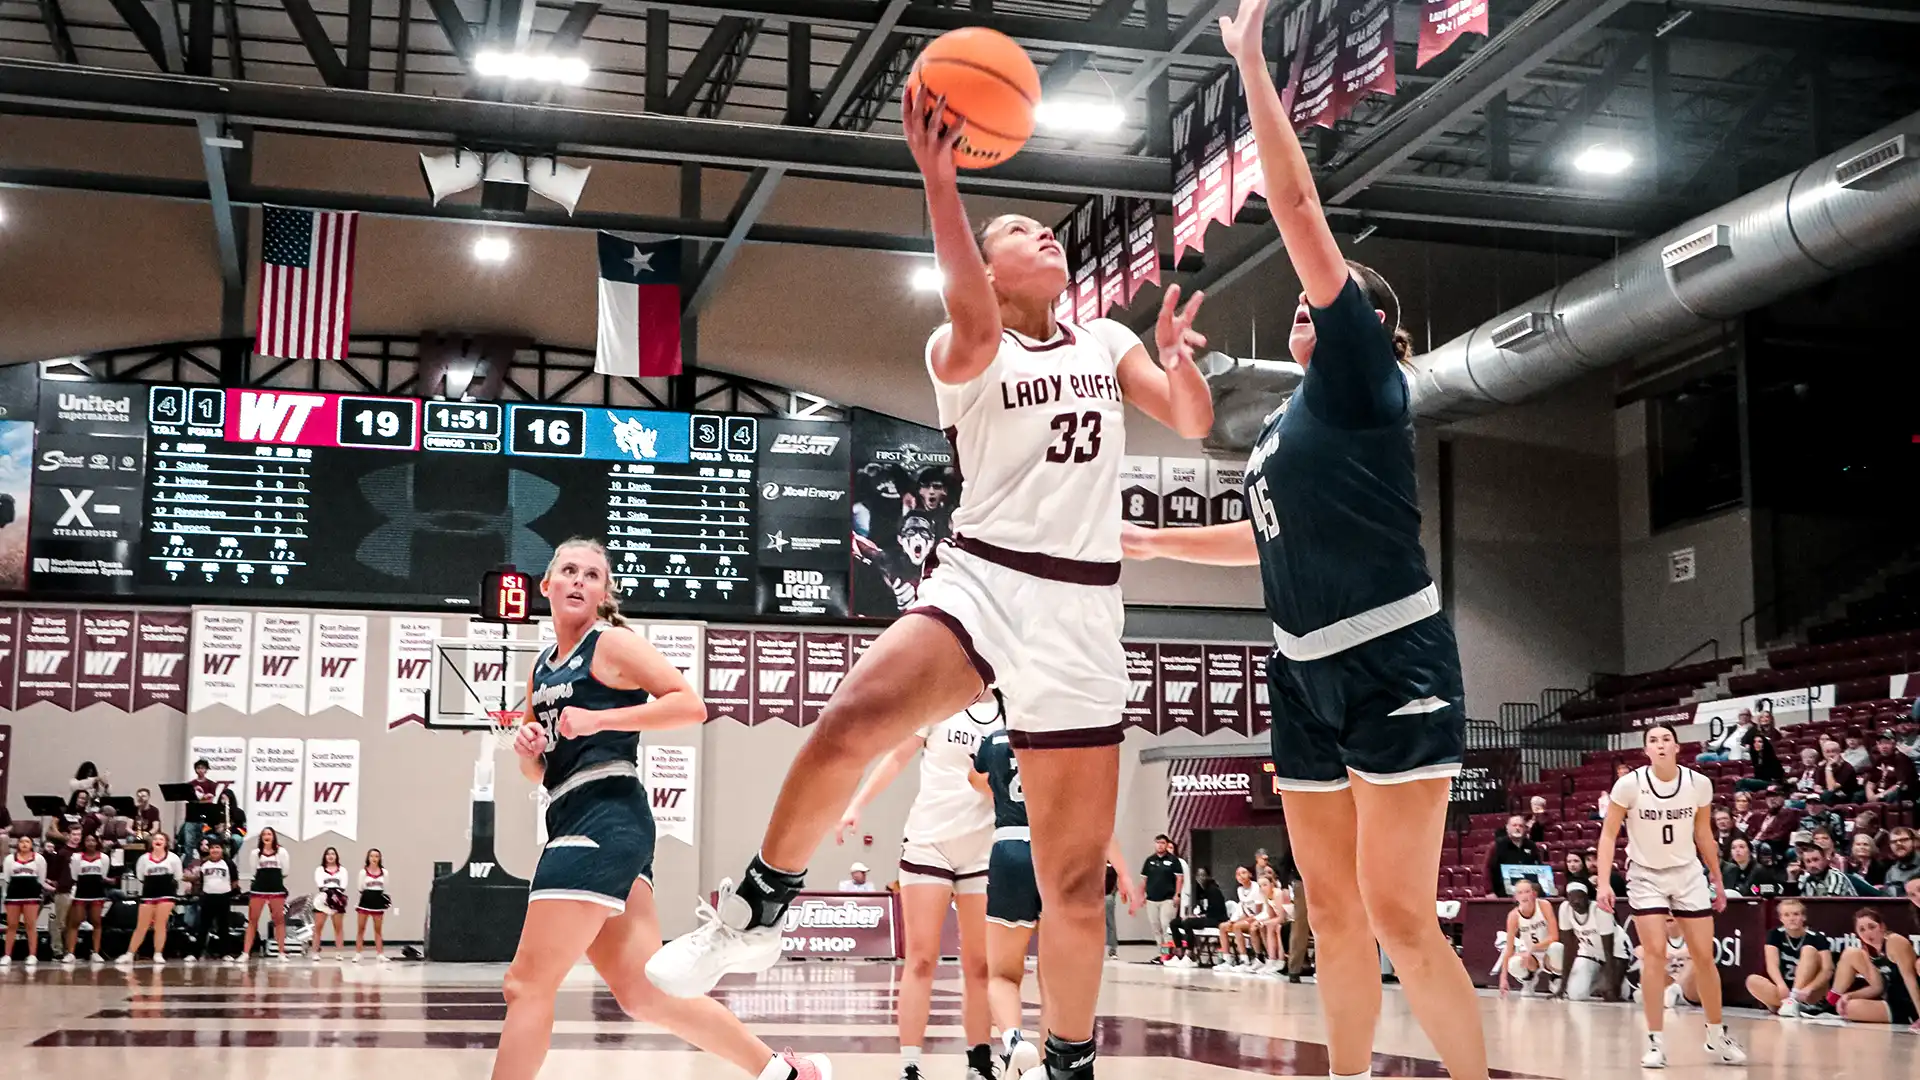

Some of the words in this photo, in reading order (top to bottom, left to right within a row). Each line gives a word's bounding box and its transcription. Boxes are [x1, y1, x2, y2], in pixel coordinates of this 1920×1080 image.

[1001, 375, 1061, 409] LADY
[58, 393, 130, 414] United
[157, 396, 177, 417] 4
[198, 398, 212, 418] 1
[58, 412, 130, 423] supermarkets
[238, 392, 326, 443] WT
[355, 410, 399, 437] 19
[436, 408, 488, 430] 1:51
[527, 418, 571, 446] 16
[699, 424, 715, 443] 3
[734, 425, 751, 444] 4
[1045, 411, 1102, 463] 33
[876, 451, 900, 461] FIRST
[917, 454, 951, 463] UNITED
[1173, 475, 1196, 483] RAMEY
[1219, 477, 1245, 485] CHEEKS
[782, 486, 808, 497] Xcel
[809, 489, 840, 501] Energy
[1129, 494, 1145, 517] 8
[1170, 496, 1199, 520] 44
[1221, 498, 1243, 521] 10
[1249, 475, 1281, 543] 45
[783, 569, 824, 585] BUD
[775, 584, 831, 600] LIGHT
[500, 588, 526, 618] 19
[262, 643, 302, 651] Scholarship
[320, 641, 359, 649] Scholarship
[25, 649, 70, 674] WT
[84, 651, 128, 676] WT
[142, 652, 185, 677] WT
[203, 653, 241, 675] WT
[262, 655, 300, 677] WT
[320, 657, 357, 678] WT
[397, 658, 431, 679] WT
[708, 668, 747, 692] WT
[759, 670, 796, 693] WT
[808, 671, 845, 694] WT
[1165, 681, 1199, 703] WT
[1210, 682, 1244, 704] WT
[947, 729, 977, 747] LADY
[255, 764, 294, 772] Scholarship
[652, 772, 688, 780] Scholarship
[255, 781, 293, 802] WT
[314, 781, 350, 802] WT
[1171, 773, 1251, 791] PARKER
[652, 788, 686, 808] WT
[1639, 809, 1663, 821] LADY
[1666, 807, 1692, 820] BUFFS
[1663, 824, 1673, 844] 0
[469, 861, 495, 879] WT
[801, 902, 884, 928] Fincher
[782, 937, 806, 951] DY
[809, 936, 857, 952] SHOP
[1825, 932, 1862, 953] orth
